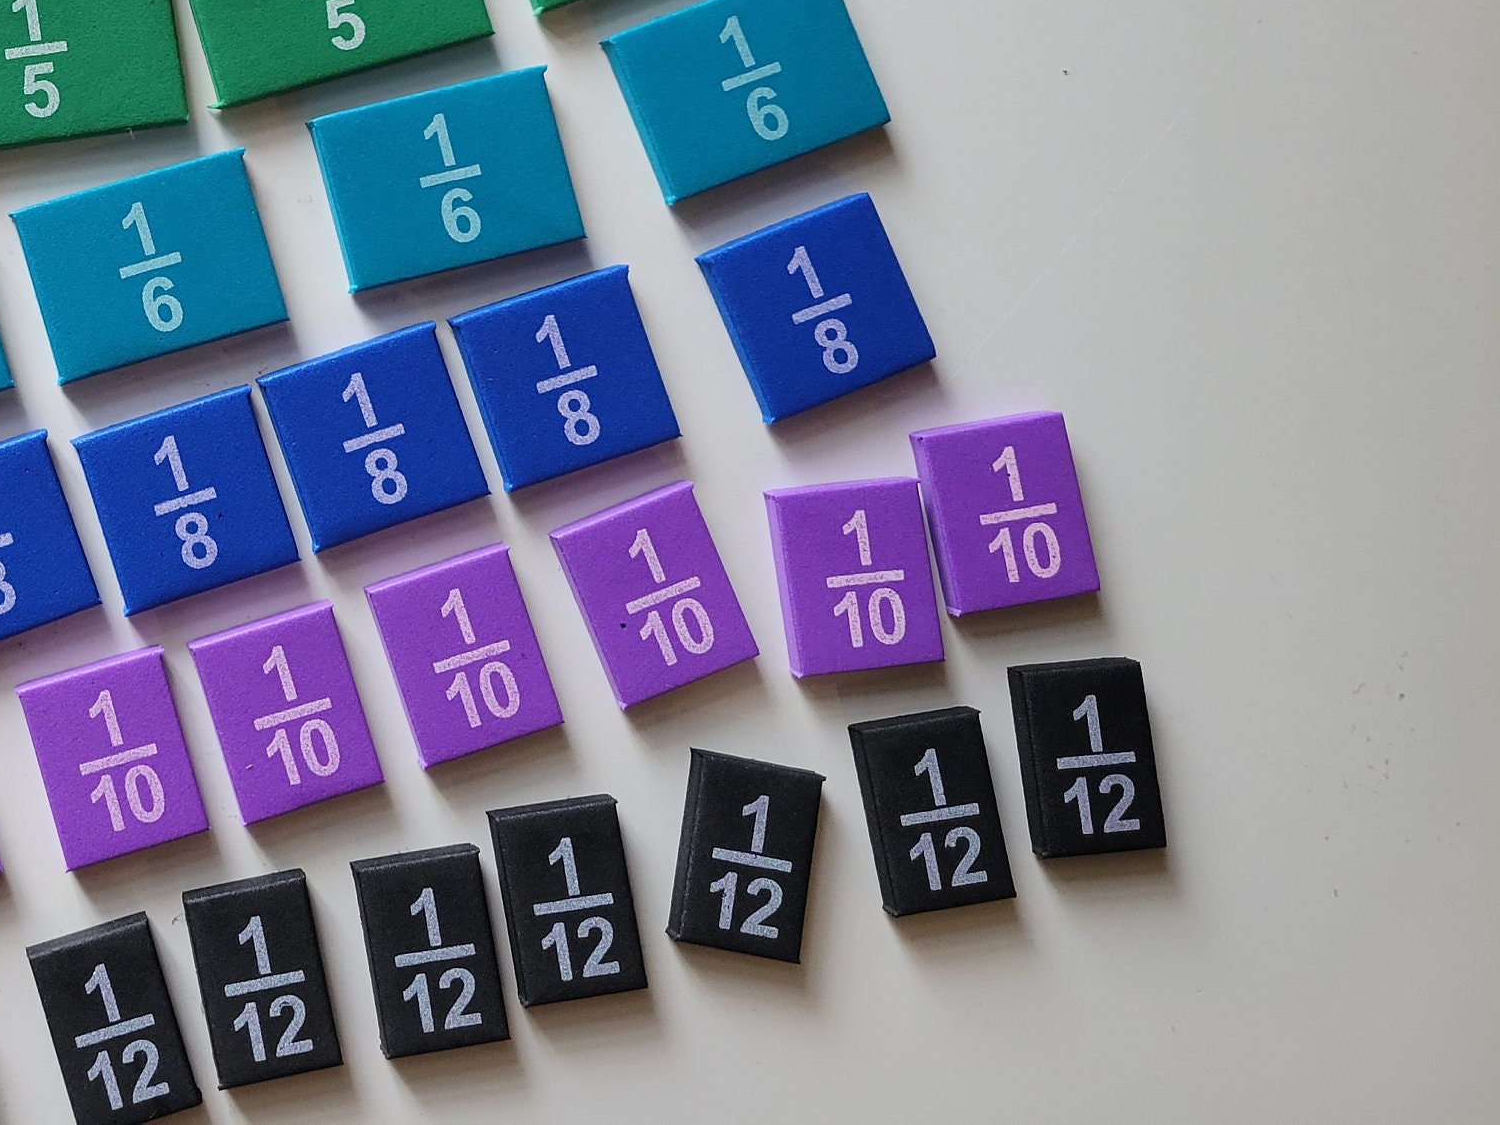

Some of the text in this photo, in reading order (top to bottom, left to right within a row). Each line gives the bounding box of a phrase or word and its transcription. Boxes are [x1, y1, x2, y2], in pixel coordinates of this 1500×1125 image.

[718, 15, 756, 68] 1
[22, 61, 61, 118] 5
[746, 86, 789, 141] 6
[423, 112, 457, 167] 1
[121, 201, 157, 257] 1
[440, 187, 482, 244] 6
[786, 245, 825, 299] 1
[141, 276, 184, 333] 6
[535, 314, 572, 370] 1
[813, 317, 860, 374] 8
[341, 371, 379, 429] 1
[557, 389, 601, 446] 8
[153, 434, 190, 492] 1
[364, 447, 408, 505] 8
[992, 445, 1025, 502] 1
[174, 511, 219, 570] 8
[628, 527, 667, 584] 1
[842, 509, 873, 566] 1
[988, 521, 1062, 583] 10
[440, 587, 477, 645] 1
[638, 597, 715, 667] 10
[833, 587, 907, 648] 10
[262, 645, 298, 702] 1
[445, 661, 520, 729] 10
[88, 689, 124, 747] 1
[1072, 694, 1104, 753] 1
[265, 718, 341, 786] 10
[913, 747, 947, 807] 1
[90, 764, 165, 832] 10
[741, 794, 770, 854] 1
[1063, 773, 1140, 835] 12
[548, 836, 581, 897] 1
[909, 826, 988, 891] 12
[410, 887, 442, 947] 1
[709, 871, 783, 937] 12
[238, 915, 272, 976] 1
[540, 916, 620, 982] 12
[84, 963, 122, 1023] 1
[402, 967, 483, 1033] 12
[233, 994, 314, 1062] 12
[87, 1039, 170, 1111] 12
